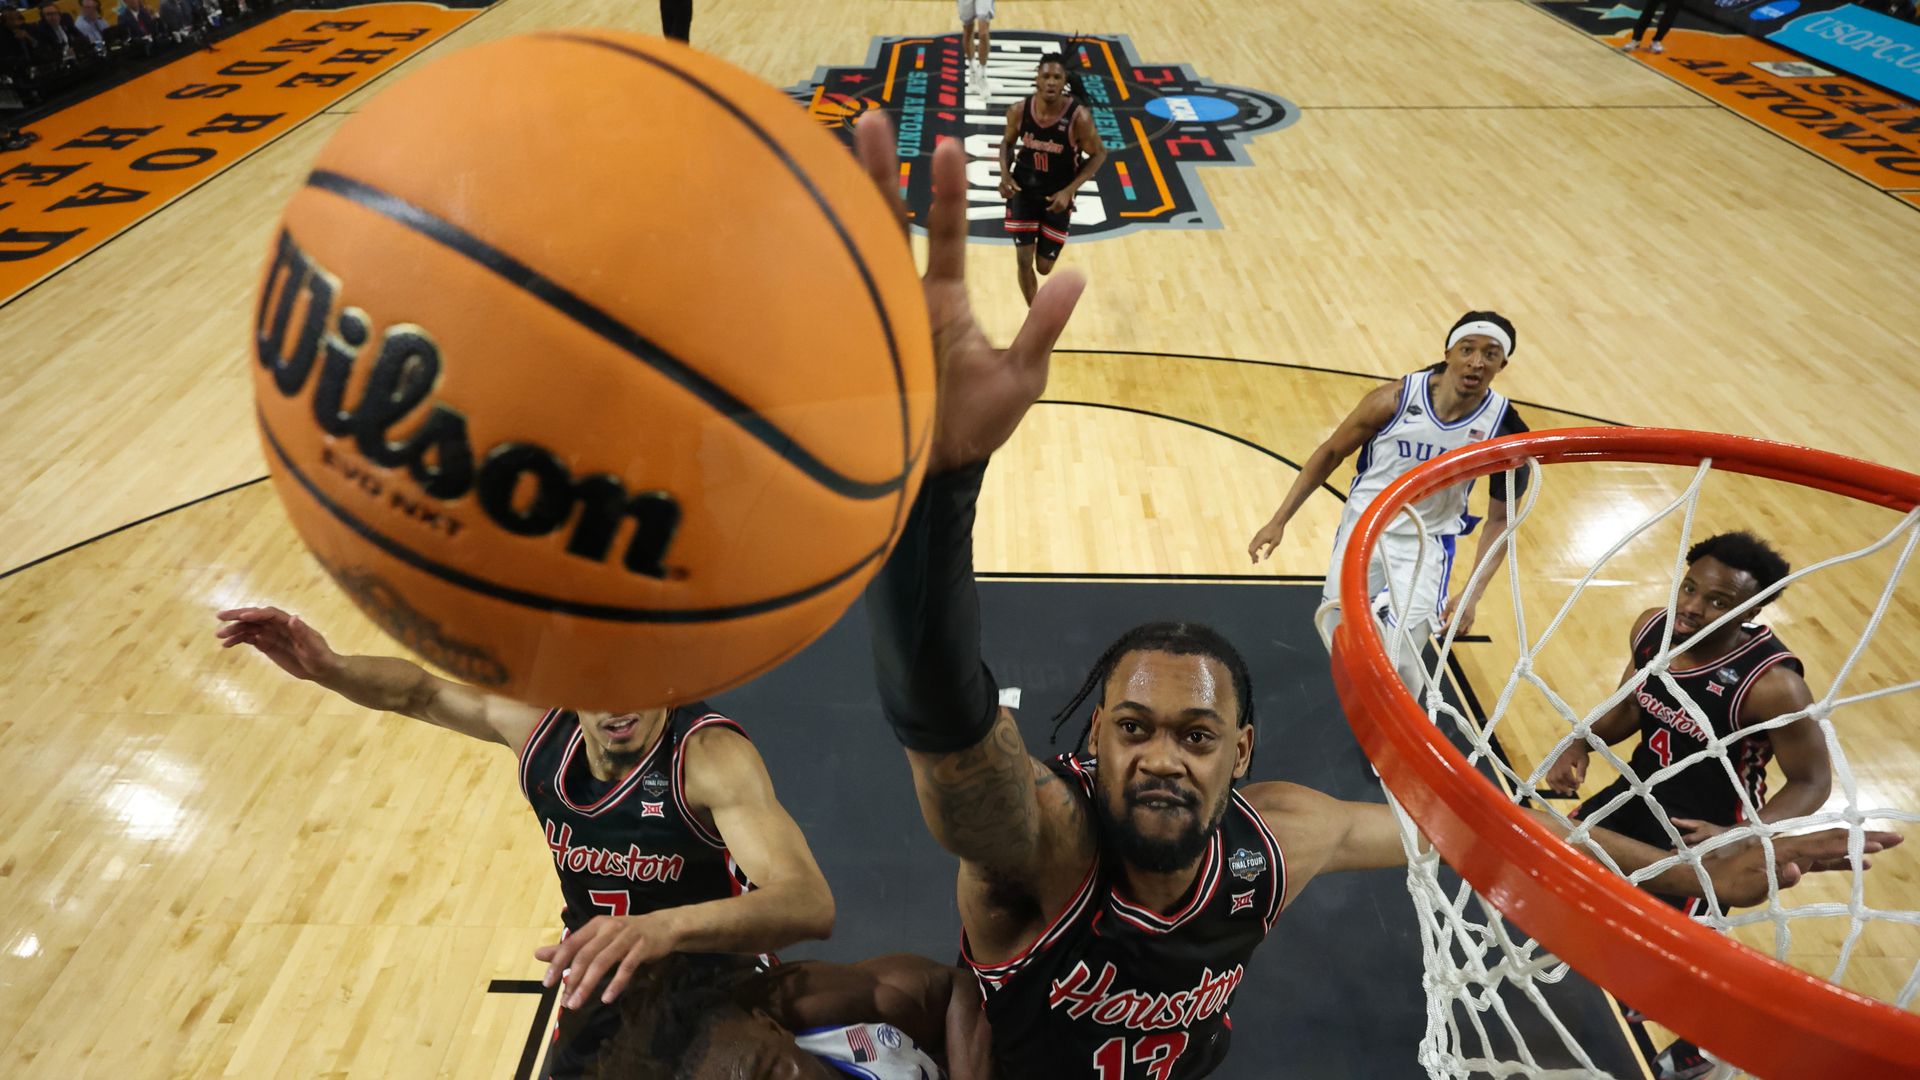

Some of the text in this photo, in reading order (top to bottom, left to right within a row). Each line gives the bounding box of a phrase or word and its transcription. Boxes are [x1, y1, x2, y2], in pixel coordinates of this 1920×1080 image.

[1804, 16, 1920, 74] USOPC.O
[0, 19, 371, 211] ENDS HE
[0, 26, 431, 262] THE ROAD
[896, 71, 928, 157] SAN ANTONIO
[1033, 152, 1049, 172] 11
[257, 227, 684, 580] Wilson
[1649, 727, 1673, 768] 4
[545, 817, 685, 883] Houston
[1231, 857, 1264, 870] FINAL FOUR
[1049, 959, 1244, 1031] Houston
[1093, 1031, 1190, 1080] 13
